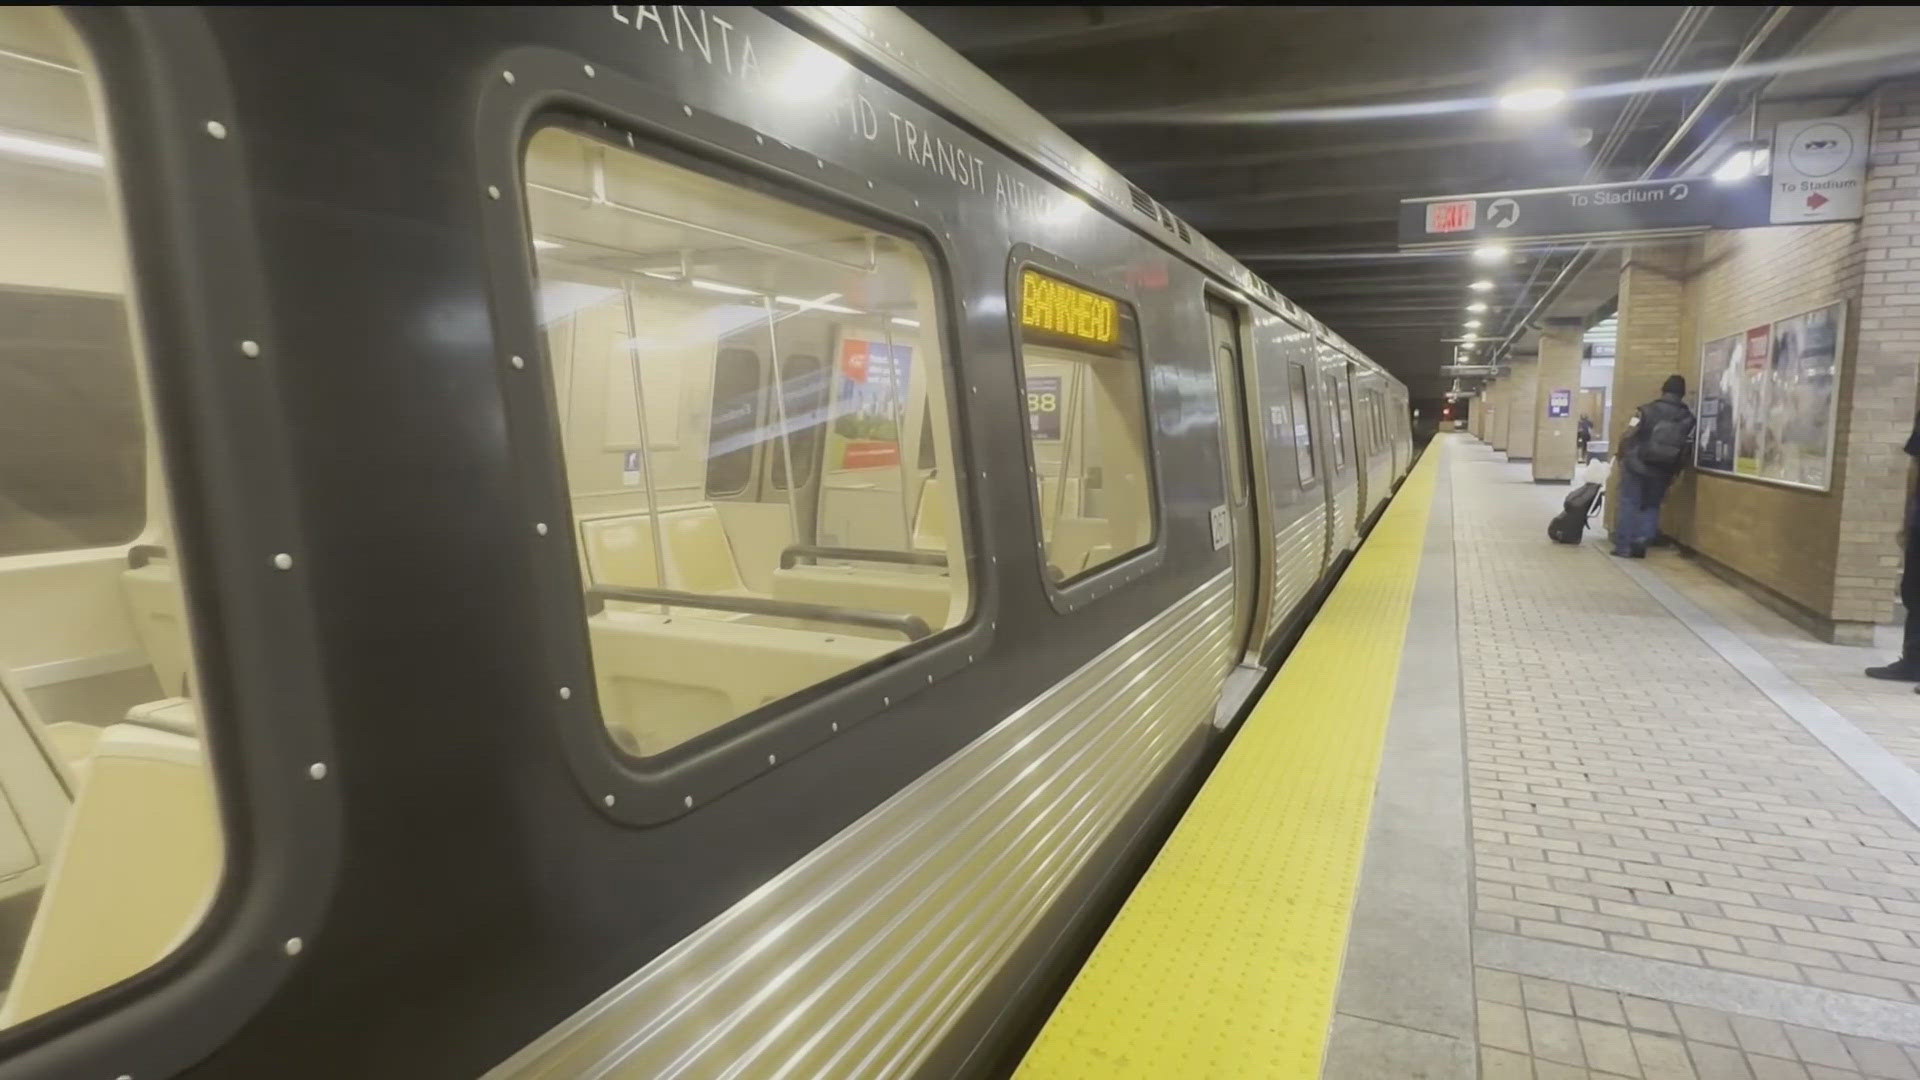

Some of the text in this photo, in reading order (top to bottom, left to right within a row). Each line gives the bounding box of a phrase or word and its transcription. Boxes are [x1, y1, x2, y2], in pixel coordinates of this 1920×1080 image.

[889, 111, 984, 195] TRANSIT
[1569, 189, 1664, 207] To Stadium
[1781, 180, 1857, 193] To Stadium
[1023, 273, 1110, 342] BANKHEAD
